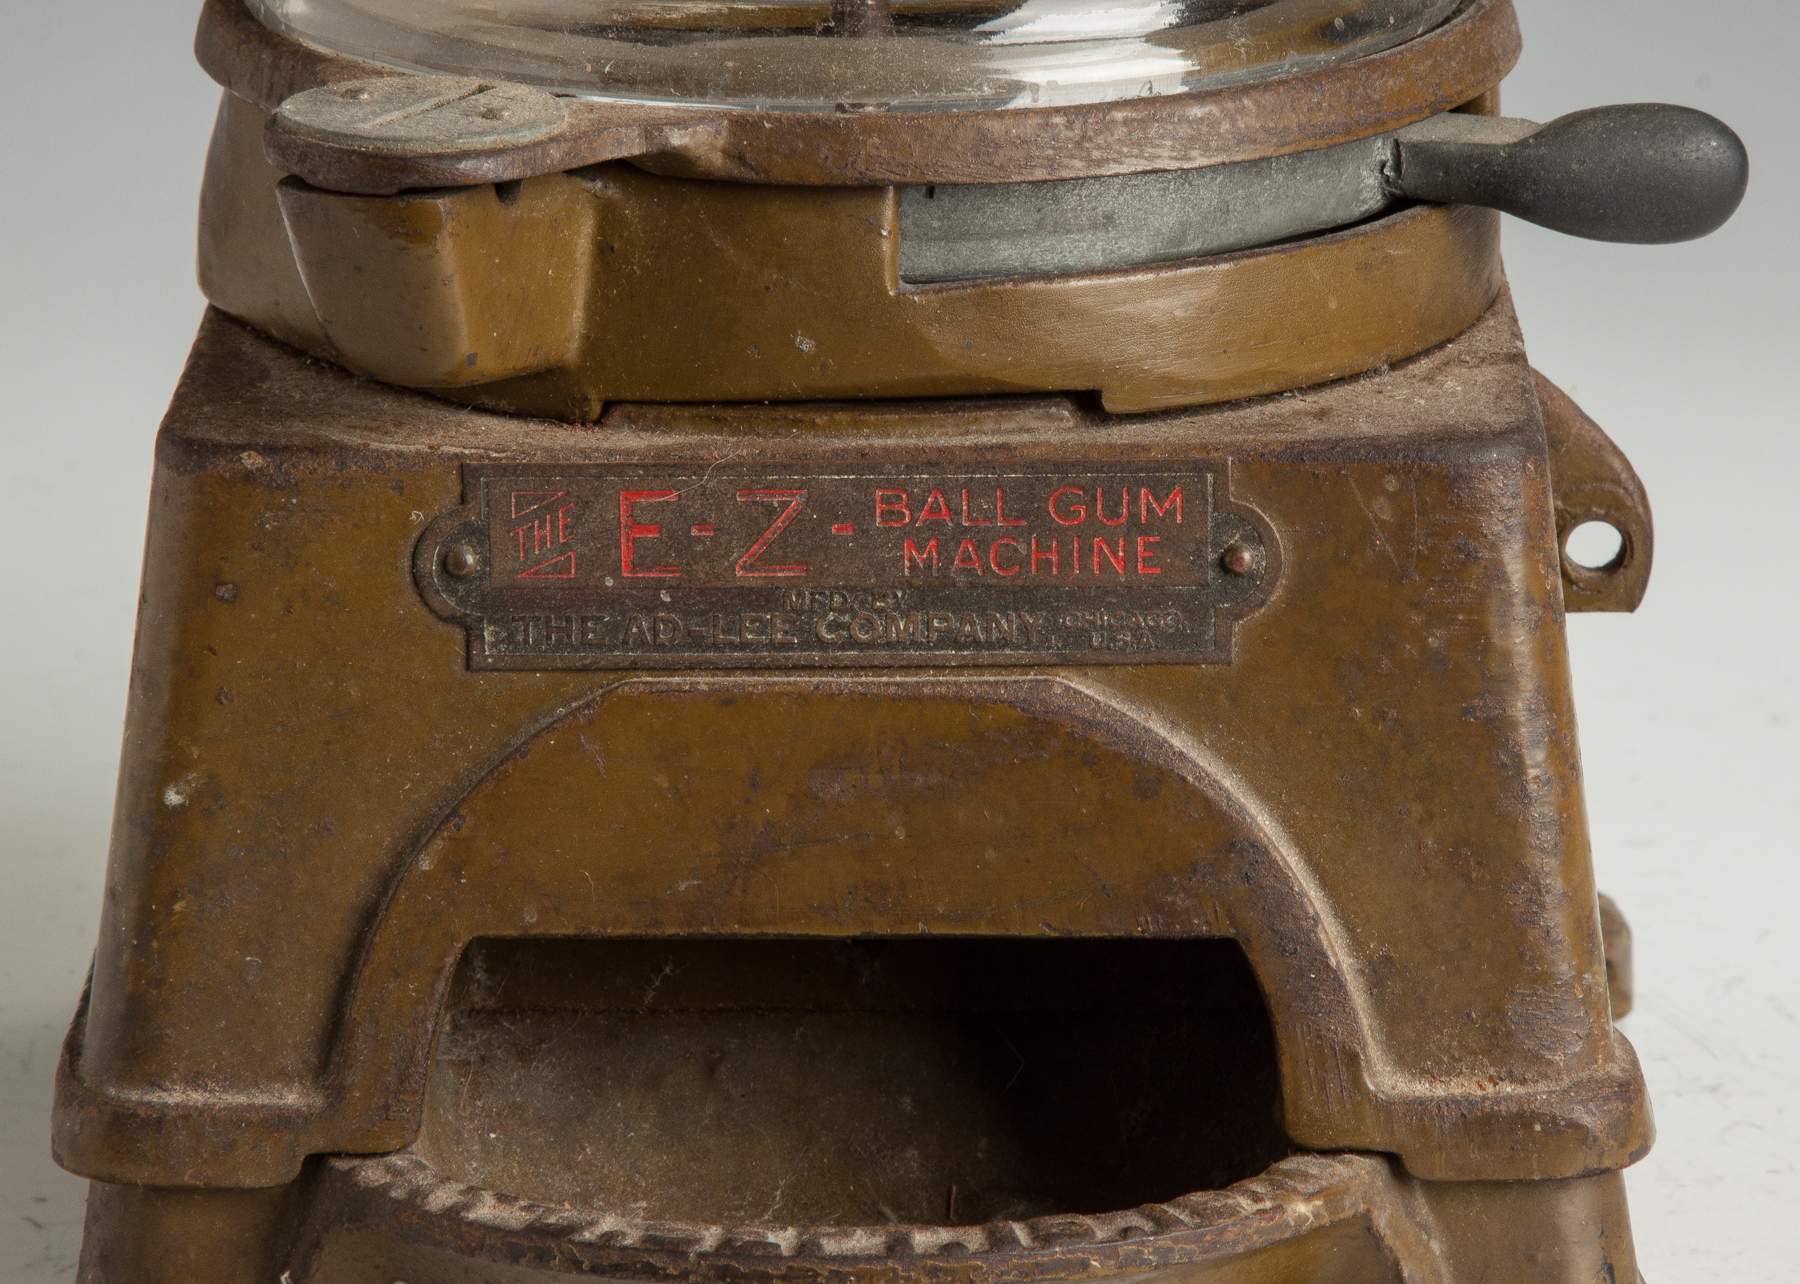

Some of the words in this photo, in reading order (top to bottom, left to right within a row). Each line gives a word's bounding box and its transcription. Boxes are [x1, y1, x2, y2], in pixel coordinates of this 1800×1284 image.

[874, 486, 1028, 527] BALL
[1047, 484, 1184, 527] GUM
[510, 502, 577, 561] THE
[903, 535, 1162, 577] MACHINE
[511, 614, 608, 645] THE
[621, 612, 799, 645] AD-LEE
